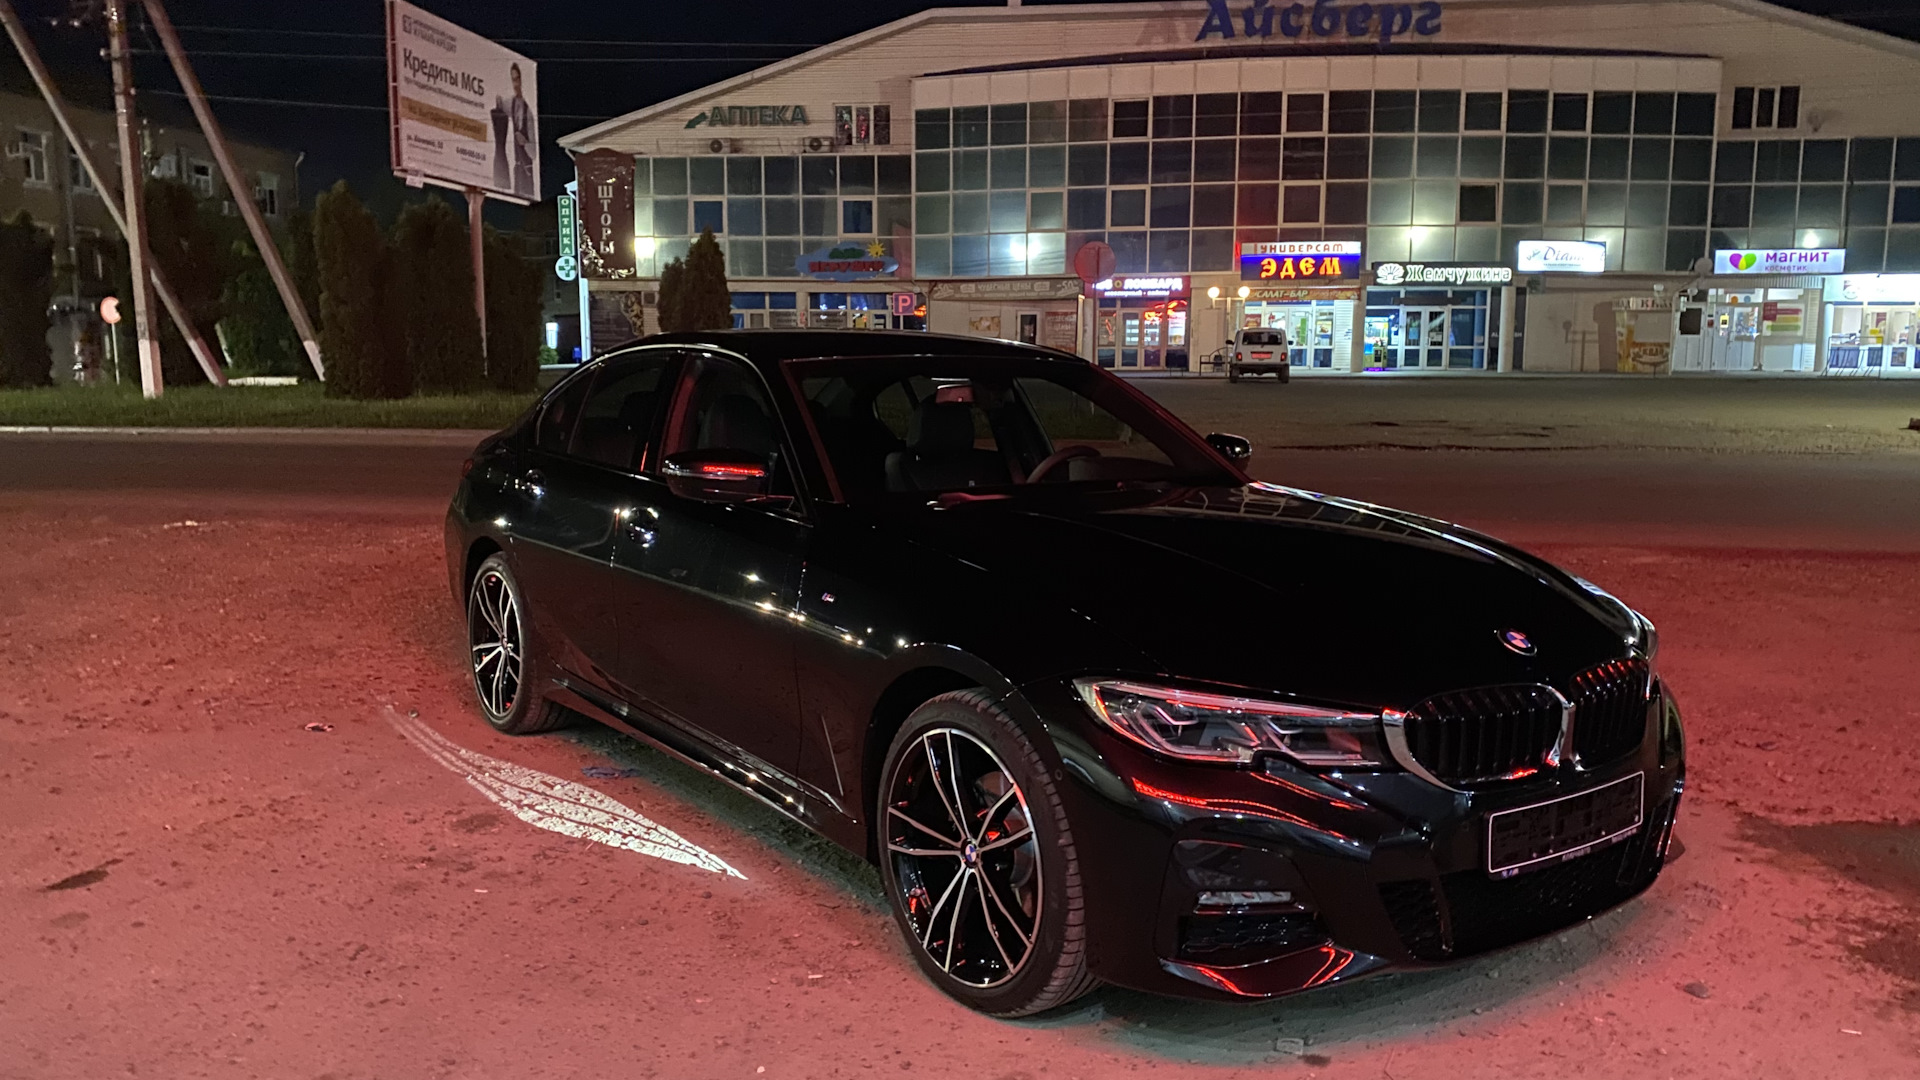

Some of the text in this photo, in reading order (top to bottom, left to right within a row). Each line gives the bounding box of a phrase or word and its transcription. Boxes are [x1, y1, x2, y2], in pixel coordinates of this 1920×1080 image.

[1195, 0, 1442, 47] Айсберг
[403, 47, 459, 86] Кредиты
[461, 71, 485, 97] МСБ
[708, 105, 808, 127] АПТЕКА
[561, 198, 571, 254] ОПТИКА
[597, 185, 615, 254] ШТОРЫ
[1260, 243, 1343, 254] УНИВЕРСАМ
[1259, 257, 1342, 279] ЭДЕМ
[1405, 265, 1512, 285] Жемчужина
[1124, 277, 1183, 291] ЛОМБАРД
[1255, 289, 1309, 299] САЛАТ-БАР
[898, 295, 911, 313] P
